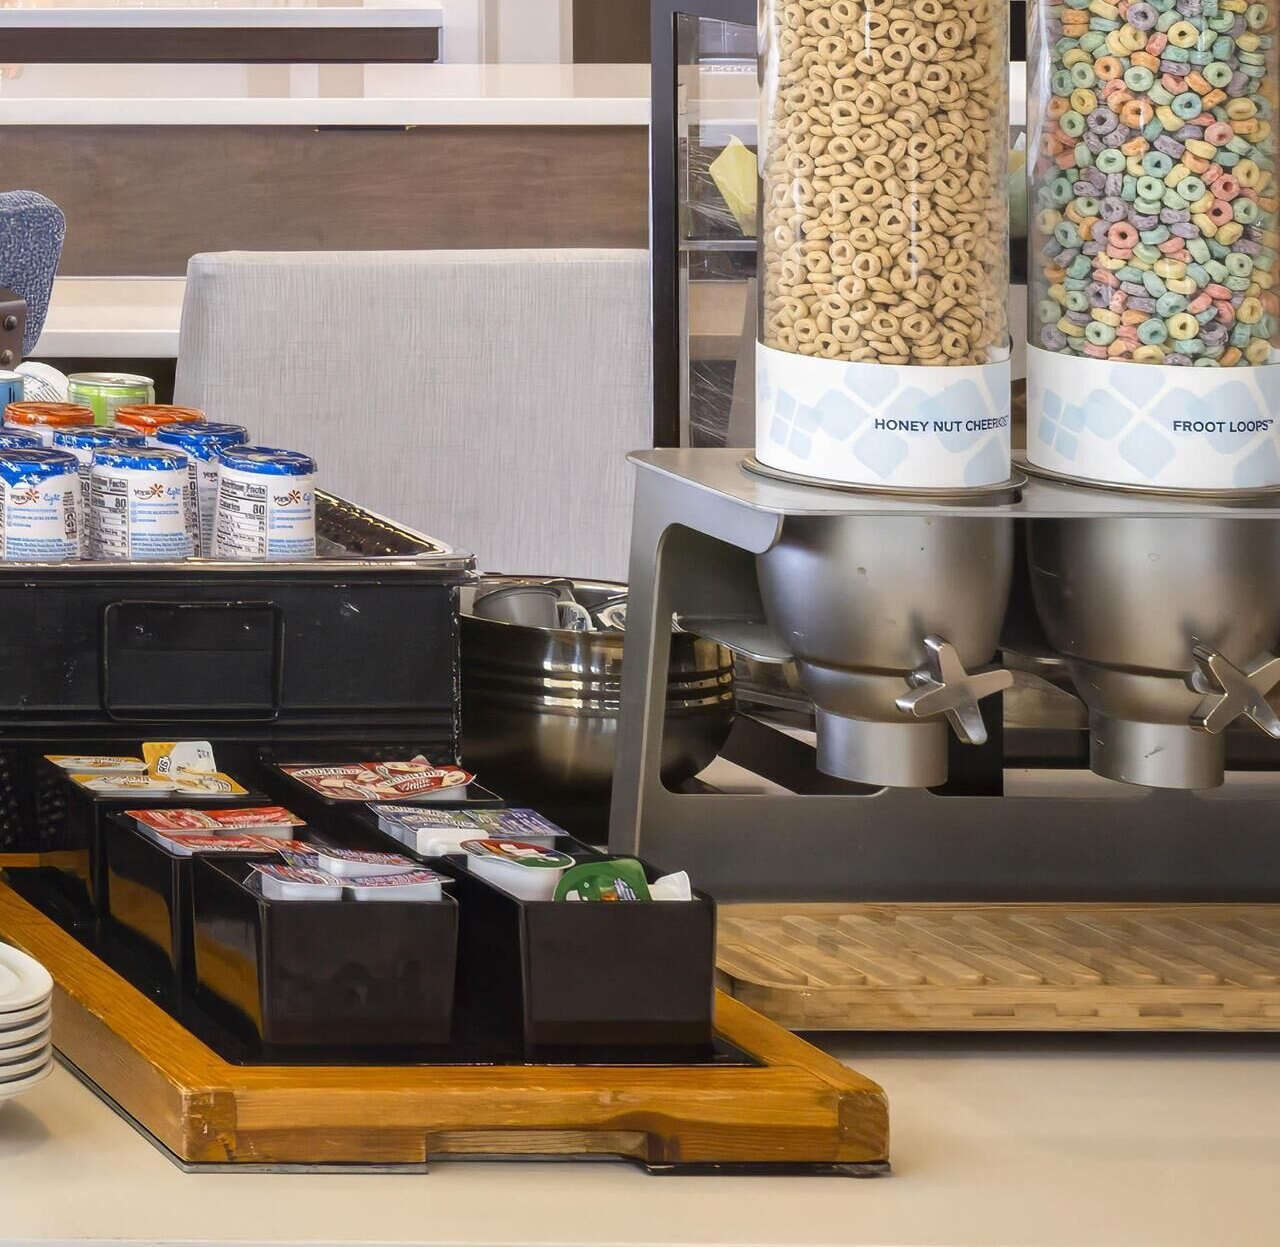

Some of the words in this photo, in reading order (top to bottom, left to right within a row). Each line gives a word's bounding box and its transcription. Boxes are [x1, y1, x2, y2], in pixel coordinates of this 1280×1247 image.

[875, 418, 928, 432] HONEY
[933, 420, 962, 432] NUT
[1173, 420, 1225, 433] FROOT
[115, 498, 126, 507] 80
